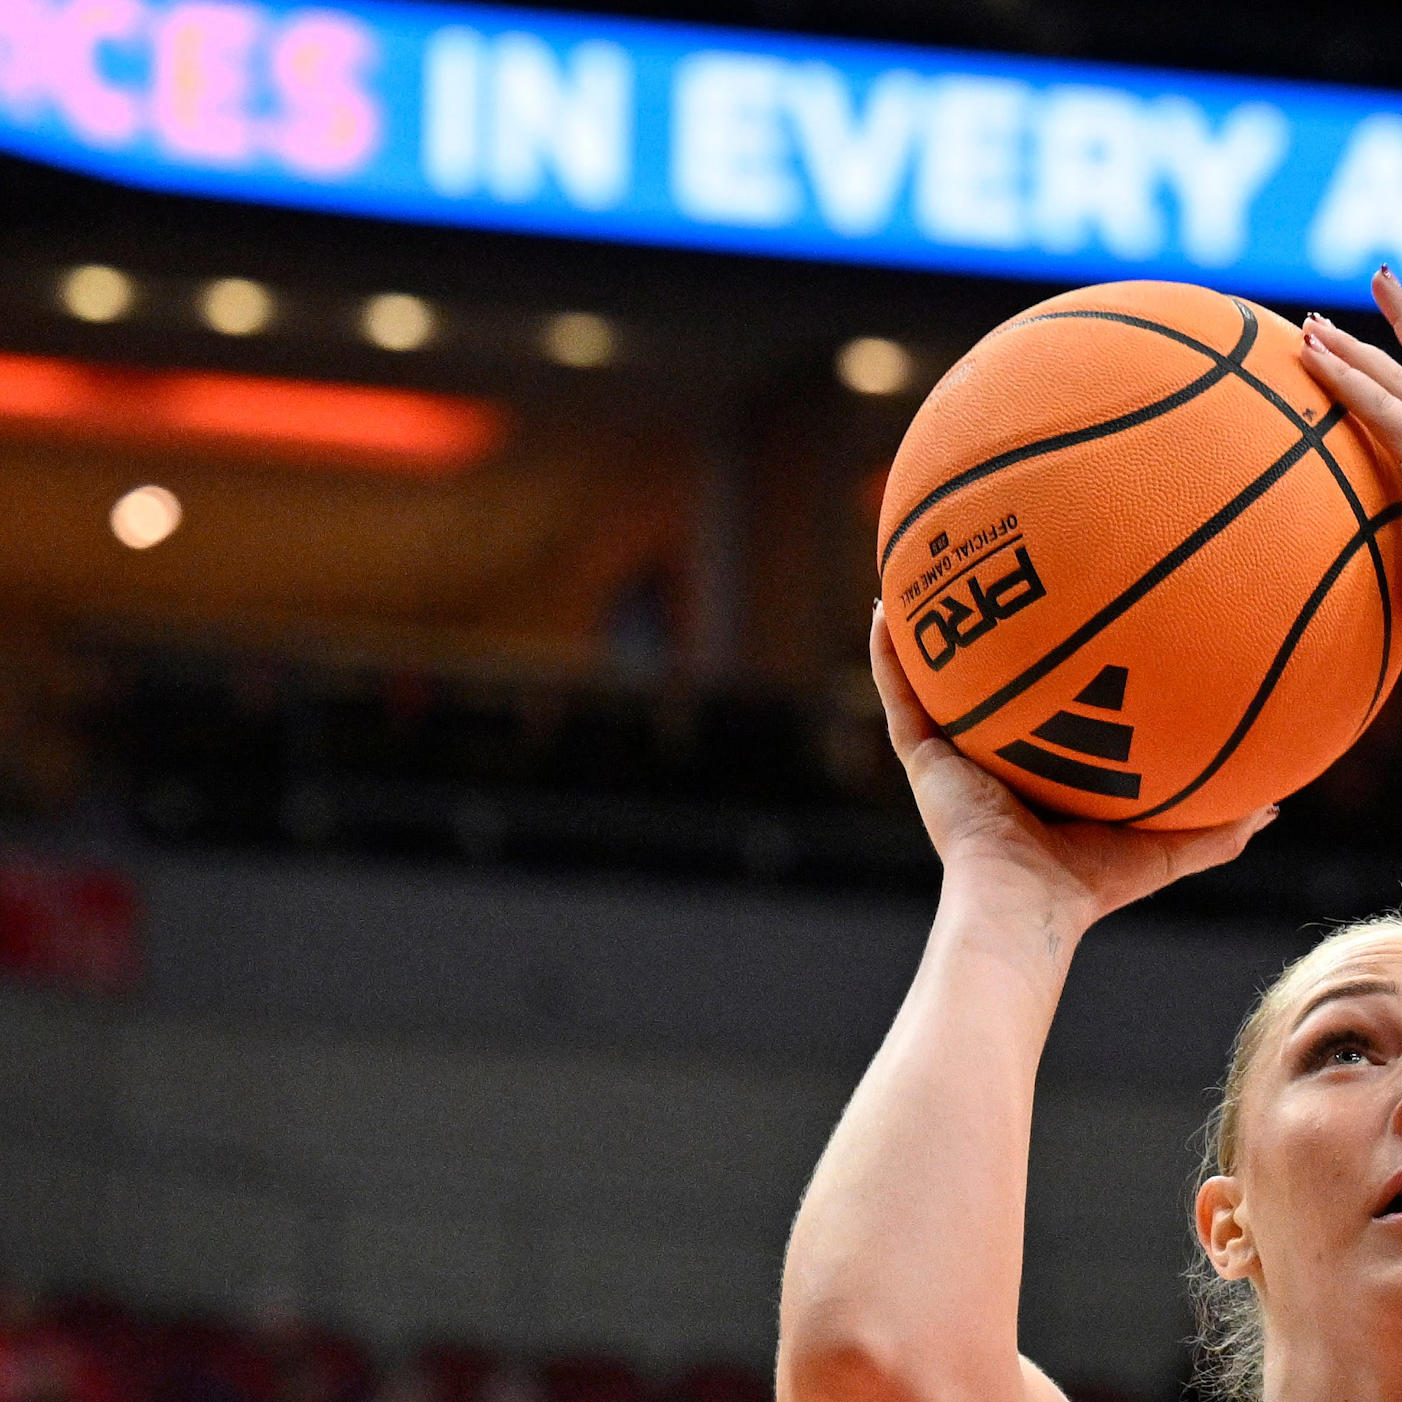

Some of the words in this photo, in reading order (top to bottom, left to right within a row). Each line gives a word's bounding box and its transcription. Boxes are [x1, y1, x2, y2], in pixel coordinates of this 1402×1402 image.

[420, 25, 635, 212] IN
[672, 48, 1290, 268] EVERY
[920, 555, 953, 591] GAME
[952, 513, 1019, 562] OFFICIAL
[914, 545, 1047, 673] PRO
